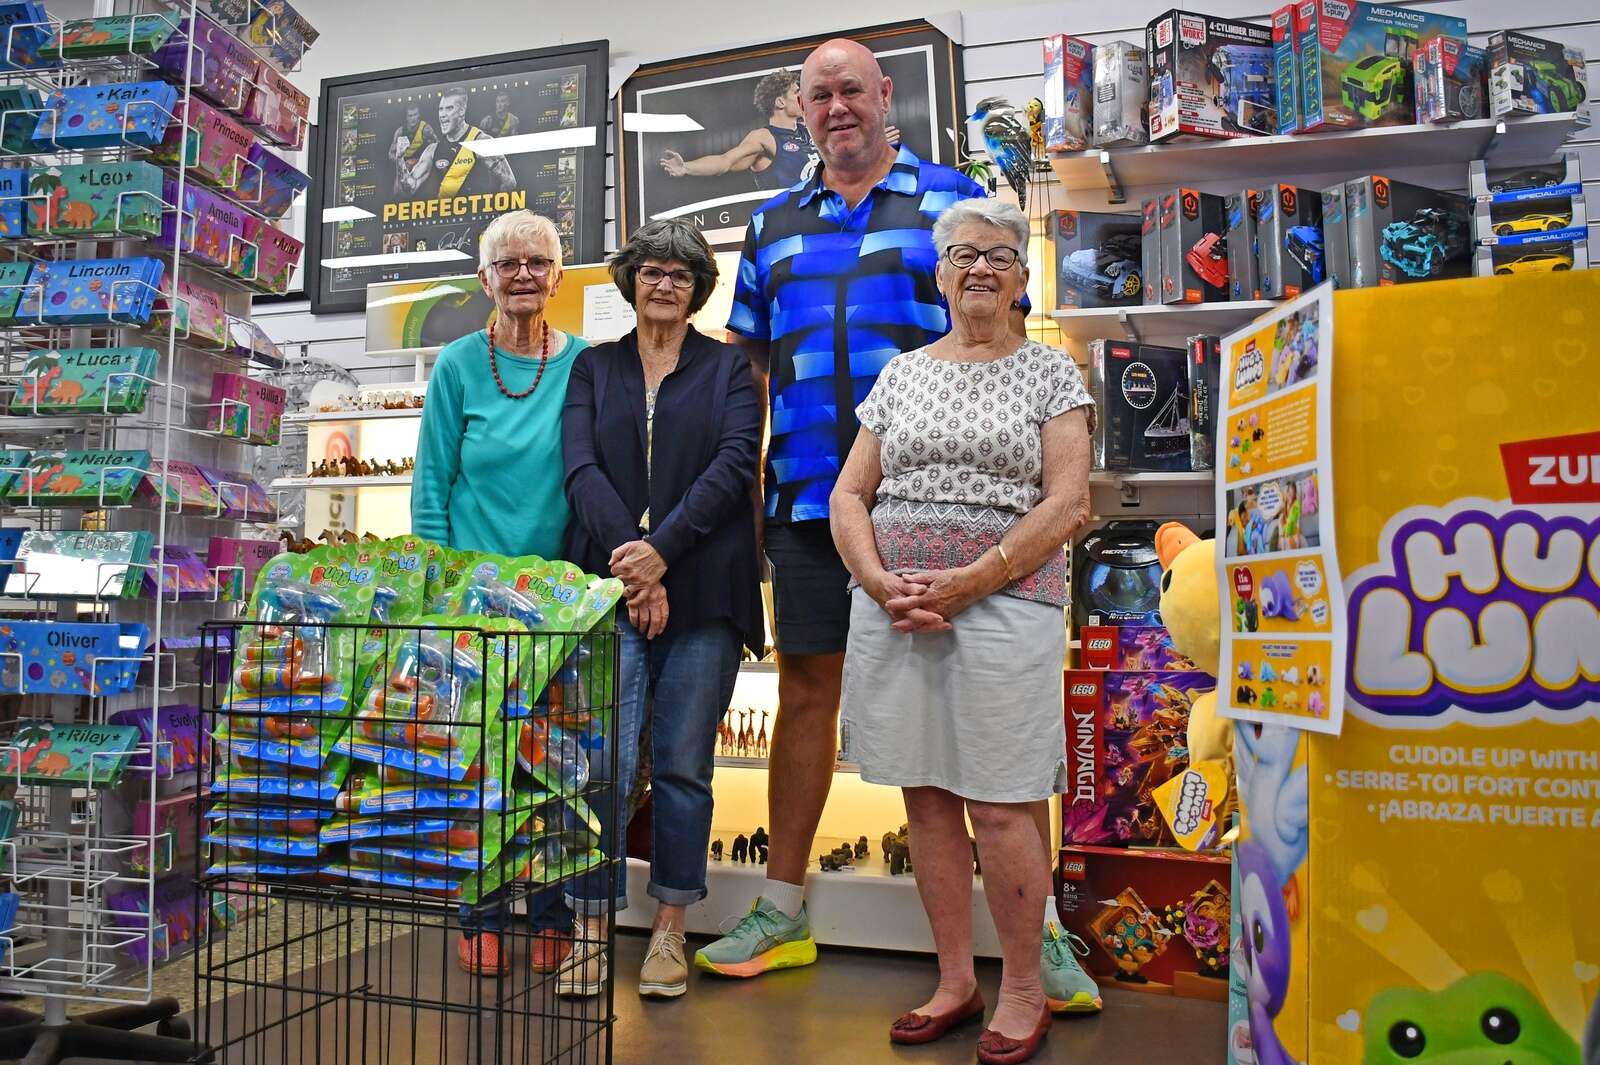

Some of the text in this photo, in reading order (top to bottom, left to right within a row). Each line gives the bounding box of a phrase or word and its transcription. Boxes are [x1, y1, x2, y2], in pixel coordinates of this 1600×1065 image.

[1366, 16, 1393, 26] CRAWLER
[1371, 7, 1425, 23] MECHANICS
[1183, 28, 1205, 41] WORKS
[1209, 21, 1247, 36] 4-CYLINDER
[1248, 28, 1271, 40] ENGINE
[1508, 36, 1546, 50] MECHANICS
[107, 87, 138, 100] Kai
[213, 117, 249, 148] Princess
[454, 157, 473, 166] Jeep
[89, 169, 124, 186] Leo
[383, 190, 526, 223] PERFECTION
[208, 202, 240, 229] Amelia
[69, 263, 130, 278] Lincoln
[76, 352, 121, 366] Luca
[79, 454, 125, 465] Nate
[1404, 522, 1600, 602] HU
[47, 631, 99, 648] Oliver
[1088, 639, 1111, 650] LEGO
[1071, 684, 1096, 696] LEGO
[66, 728, 111, 746] Riley
[1072, 707, 1095, 807] NINJAGO
[1389, 745, 1598, 770] CUDDLE UP WITH
[1336, 769, 1459, 793] SERRE-TOI
[1463, 775, 1531, 796] FORT
[1379, 799, 1485, 823] ¡ABRAZA
[1489, 805, 1587, 828] FUERTE
[1064, 863, 1084, 872] LEGO
[1063, 883, 1077, 892] 8+
